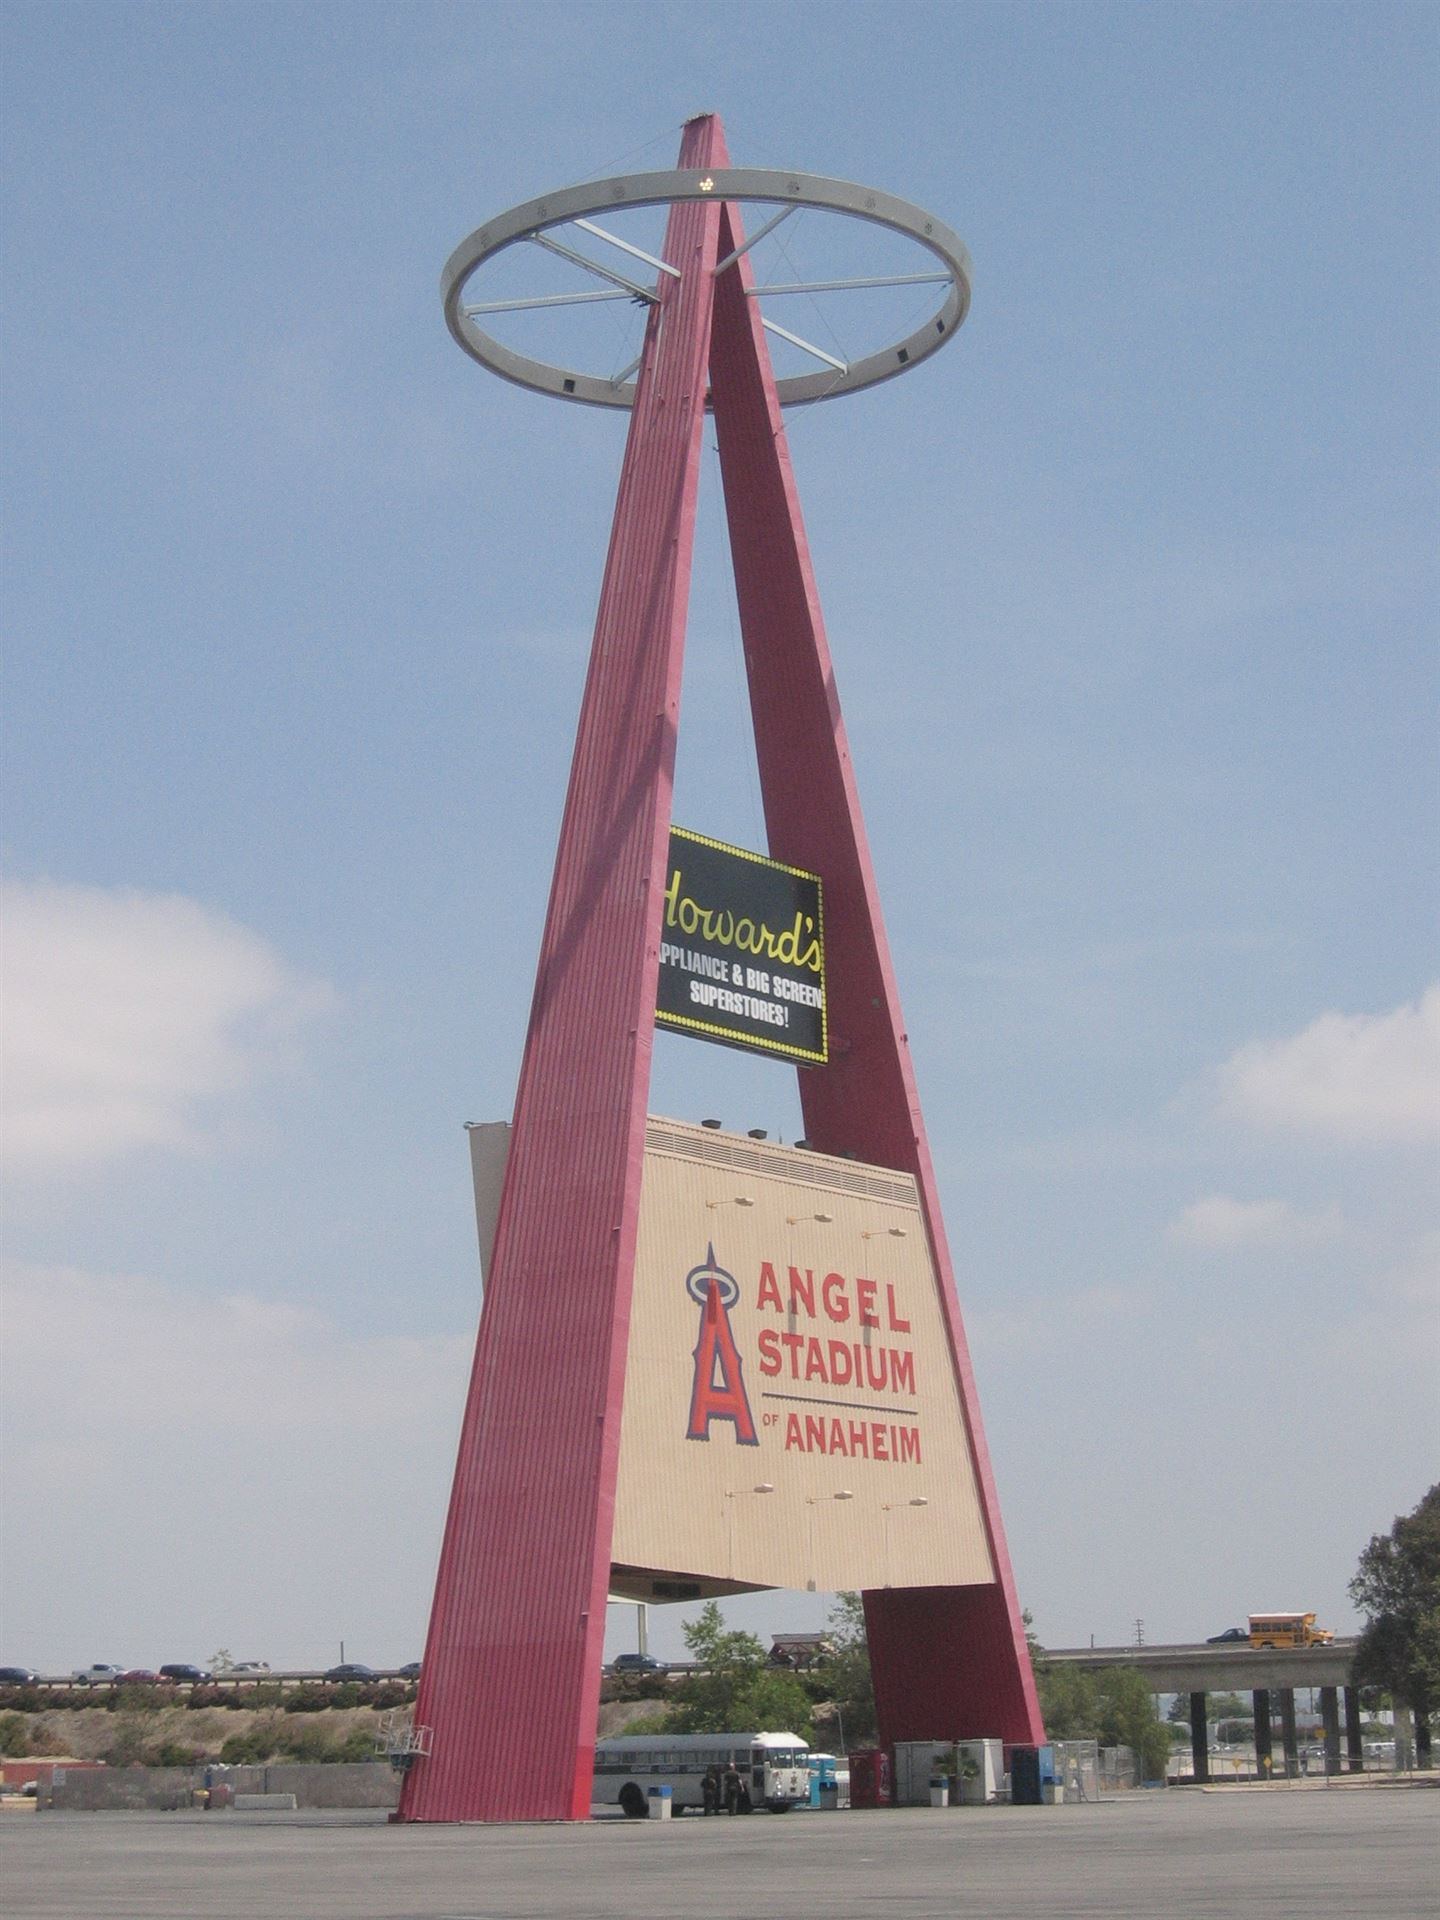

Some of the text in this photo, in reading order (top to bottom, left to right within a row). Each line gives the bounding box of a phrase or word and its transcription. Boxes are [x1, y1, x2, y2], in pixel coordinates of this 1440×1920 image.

[659, 942, 823, 1010] PPLIANCE & BIG SCREEN
[690, 980, 789, 1028] SUPERSTORES!
[756, 1262, 911, 1334] ANGEL
[758, 1328, 916, 1395] STADIUM
[762, 1413, 922, 1465] OF ANAHEIM
